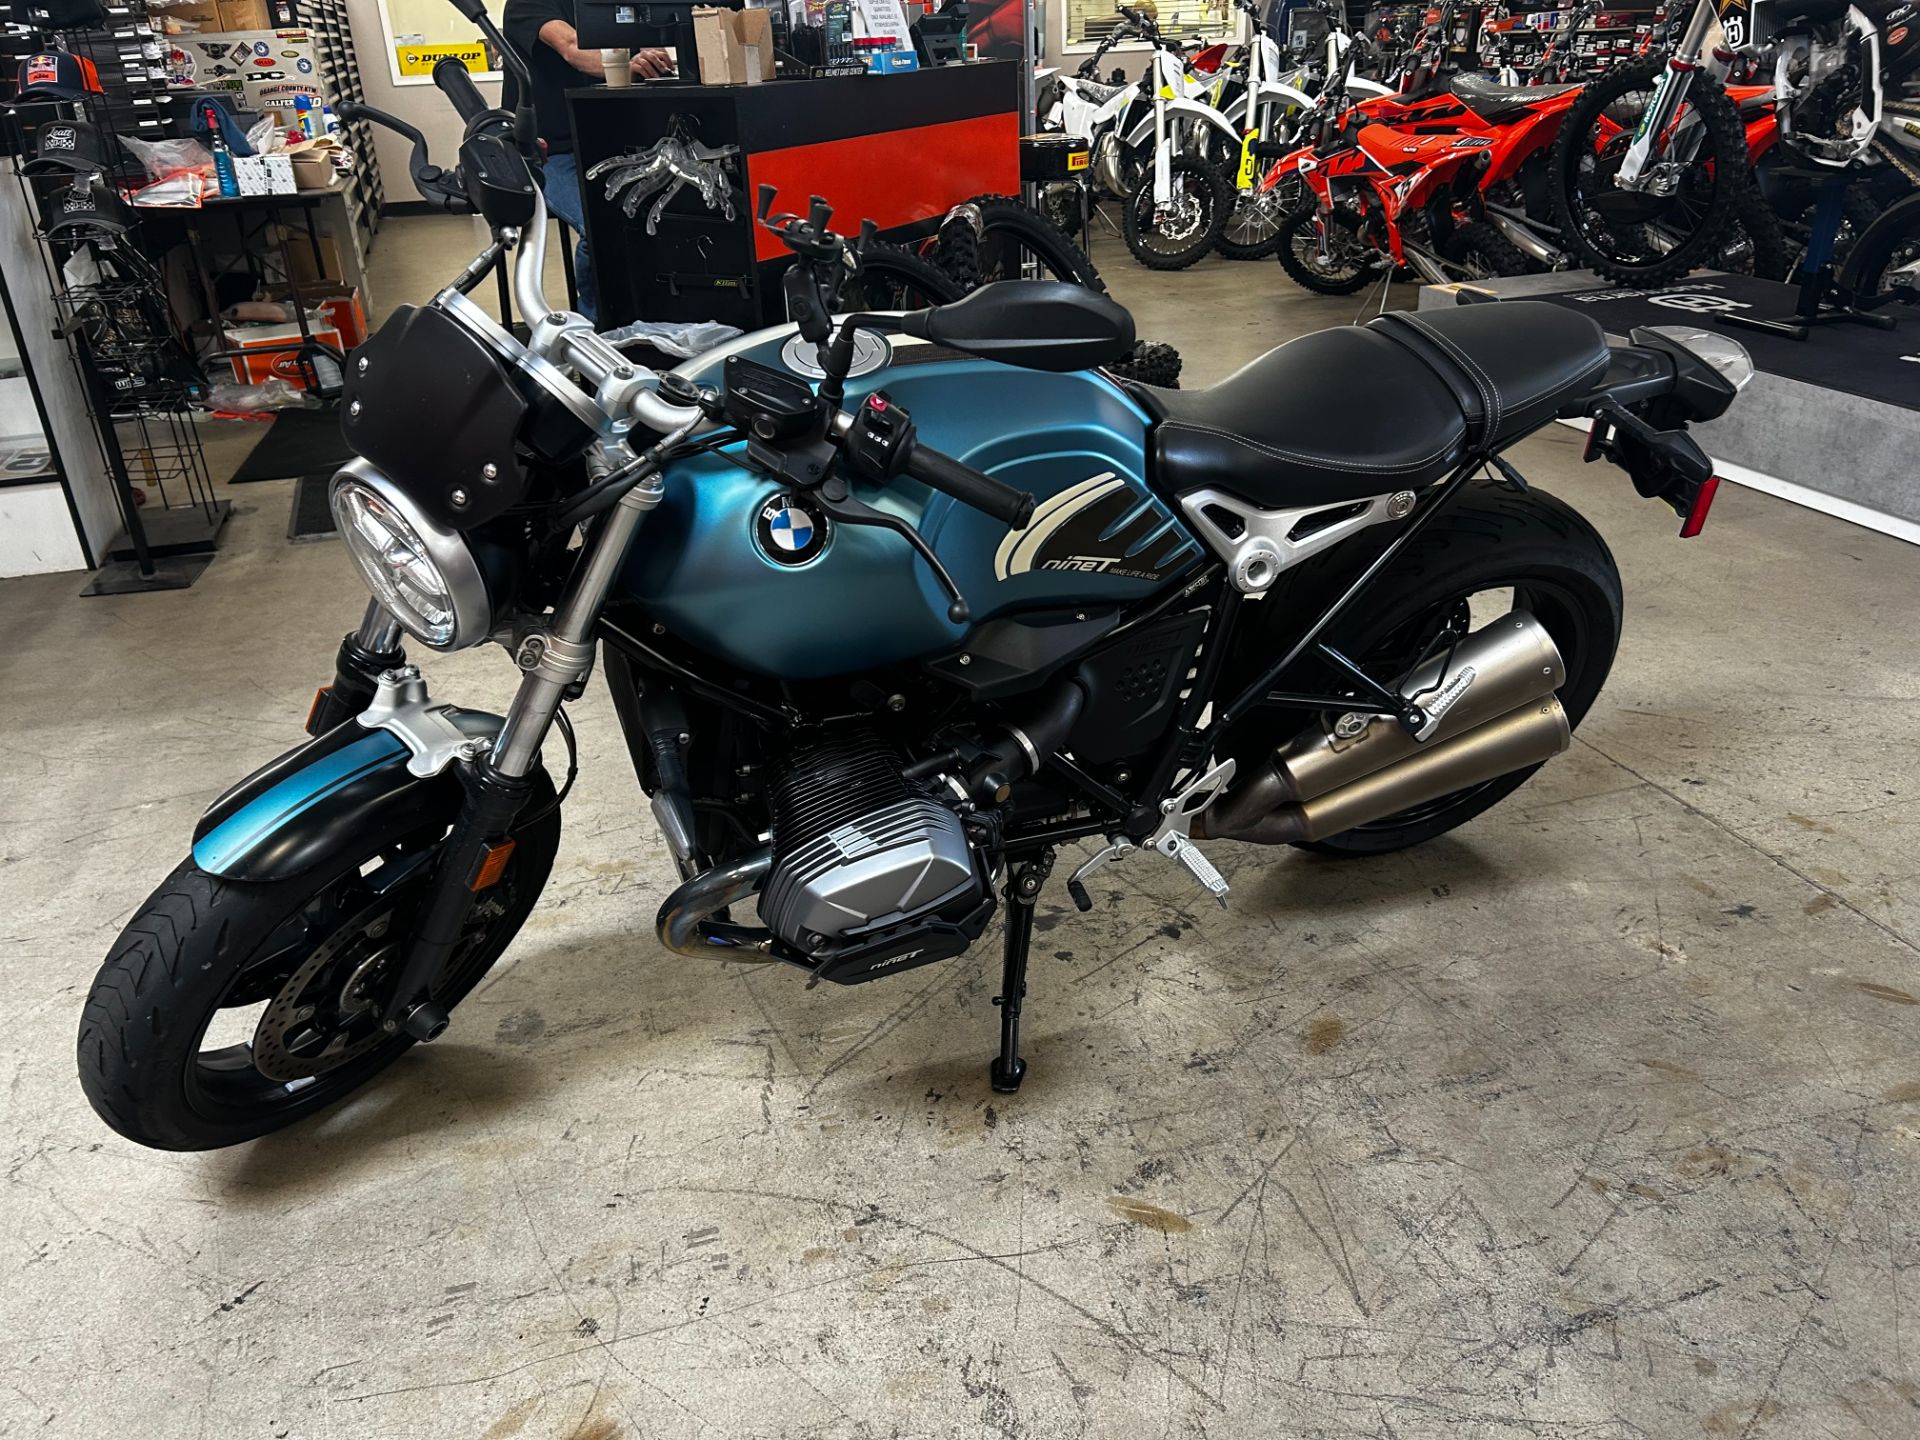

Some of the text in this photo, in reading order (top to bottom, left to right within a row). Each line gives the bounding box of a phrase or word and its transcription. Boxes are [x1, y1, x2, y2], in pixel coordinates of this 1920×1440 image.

[259, 86, 280, 96] ORANGE
[281, 84, 303, 92] COUNTY
[47, 128, 72, 140] Leatt
[1041, 555, 1121, 573] nineT
[1109, 567, 1127, 575] MAKE
[1127, 569, 1142, 577] LIFE
[1146, 572, 1160, 580] RIDE
[870, 949, 924, 970] nineT
